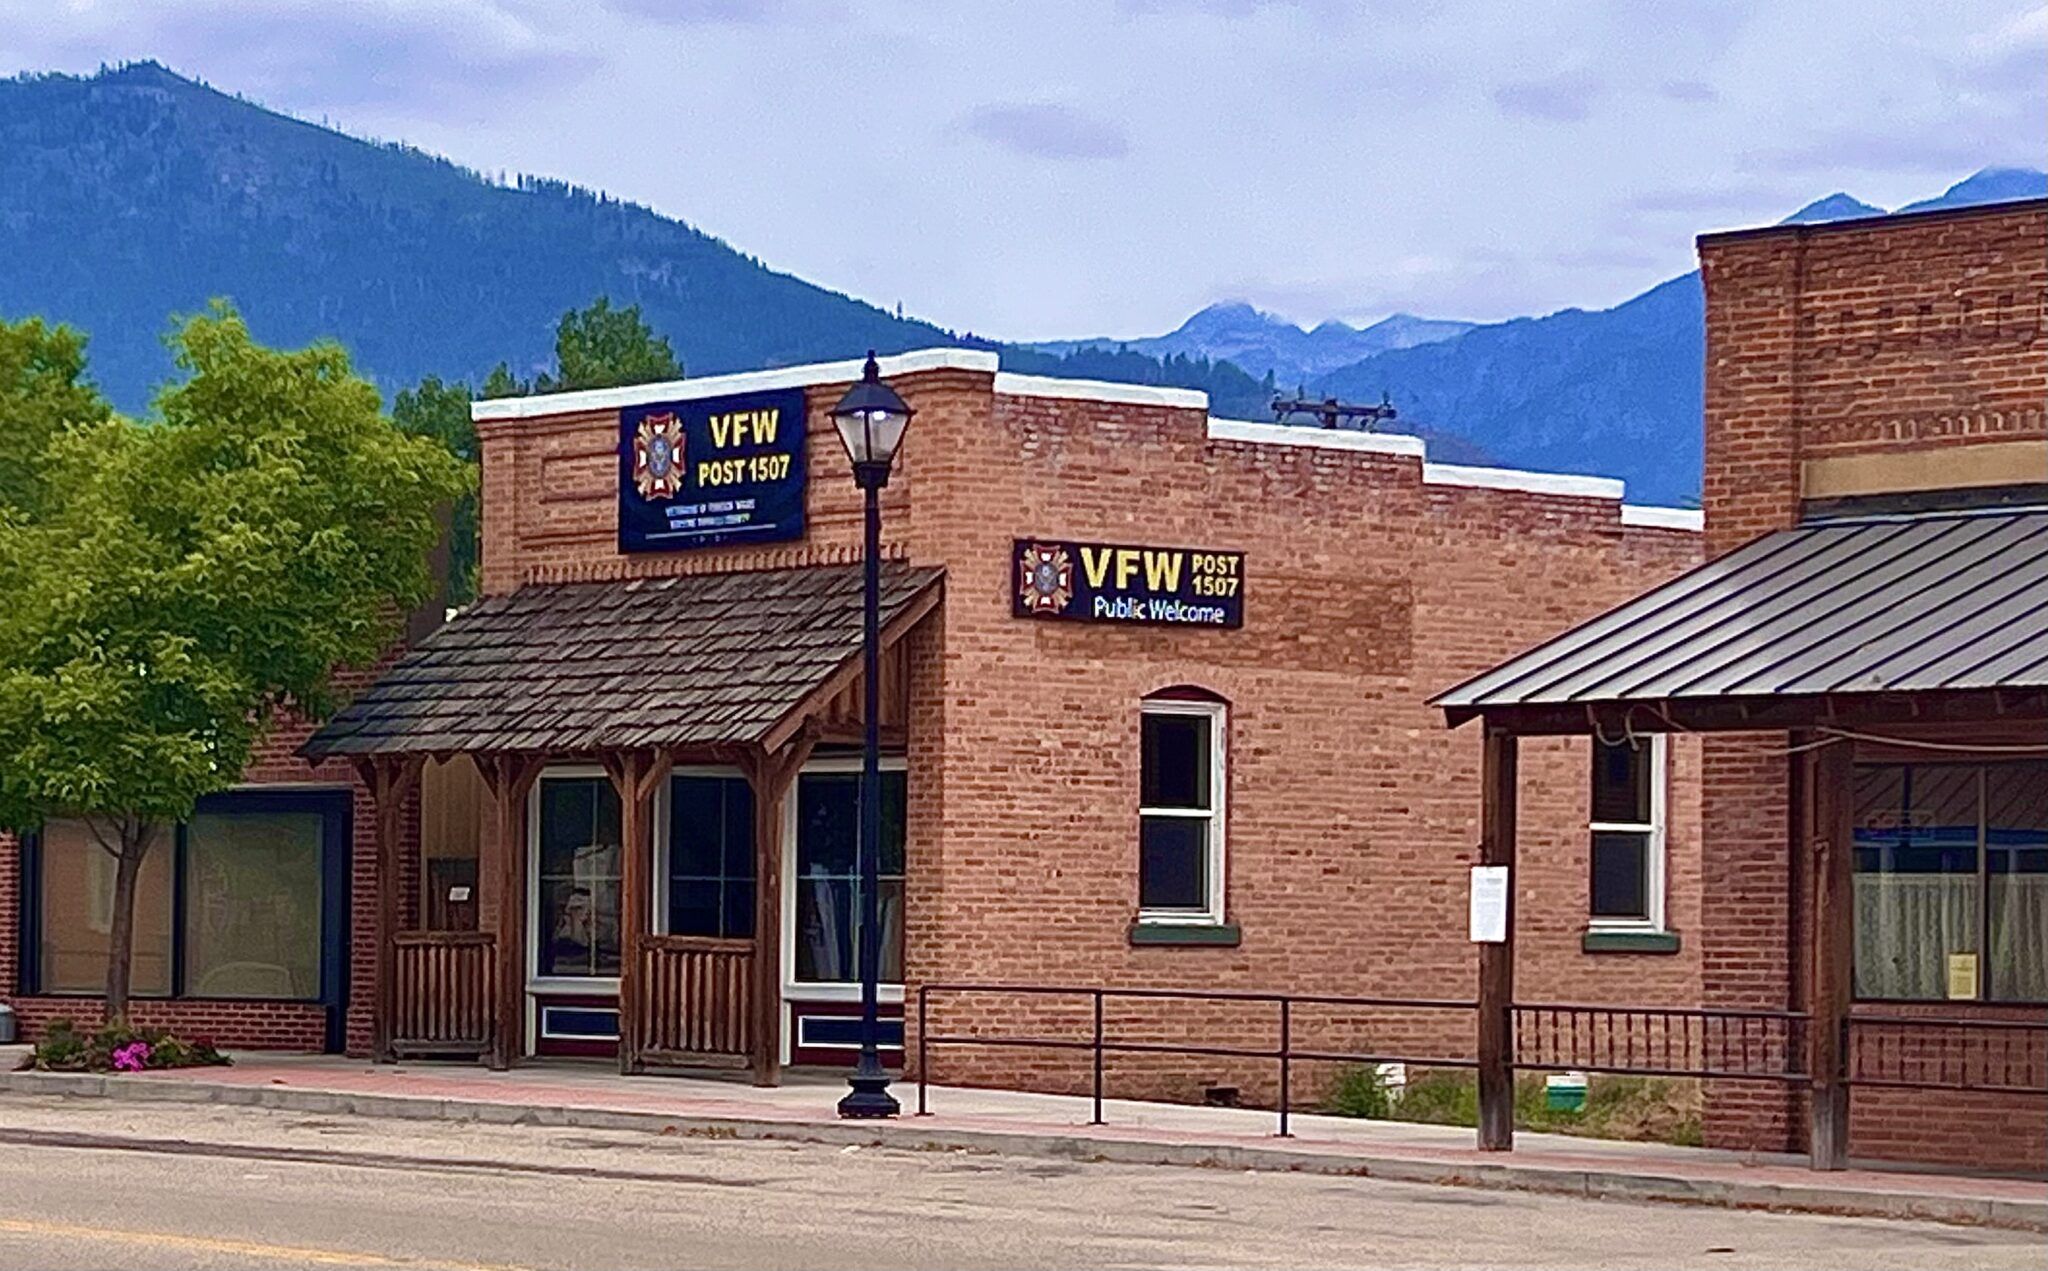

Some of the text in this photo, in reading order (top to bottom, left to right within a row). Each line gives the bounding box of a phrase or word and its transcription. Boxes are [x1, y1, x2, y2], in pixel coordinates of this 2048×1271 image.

[709, 409, 779, 448] VFW
[698, 454, 791, 488] POST 1507
[1080, 546, 1183, 593] VFW
[1191, 554, 1239, 575] POST
[1191, 576, 1239, 597] 1507
[1094, 596, 1226, 624] Public Welcome
